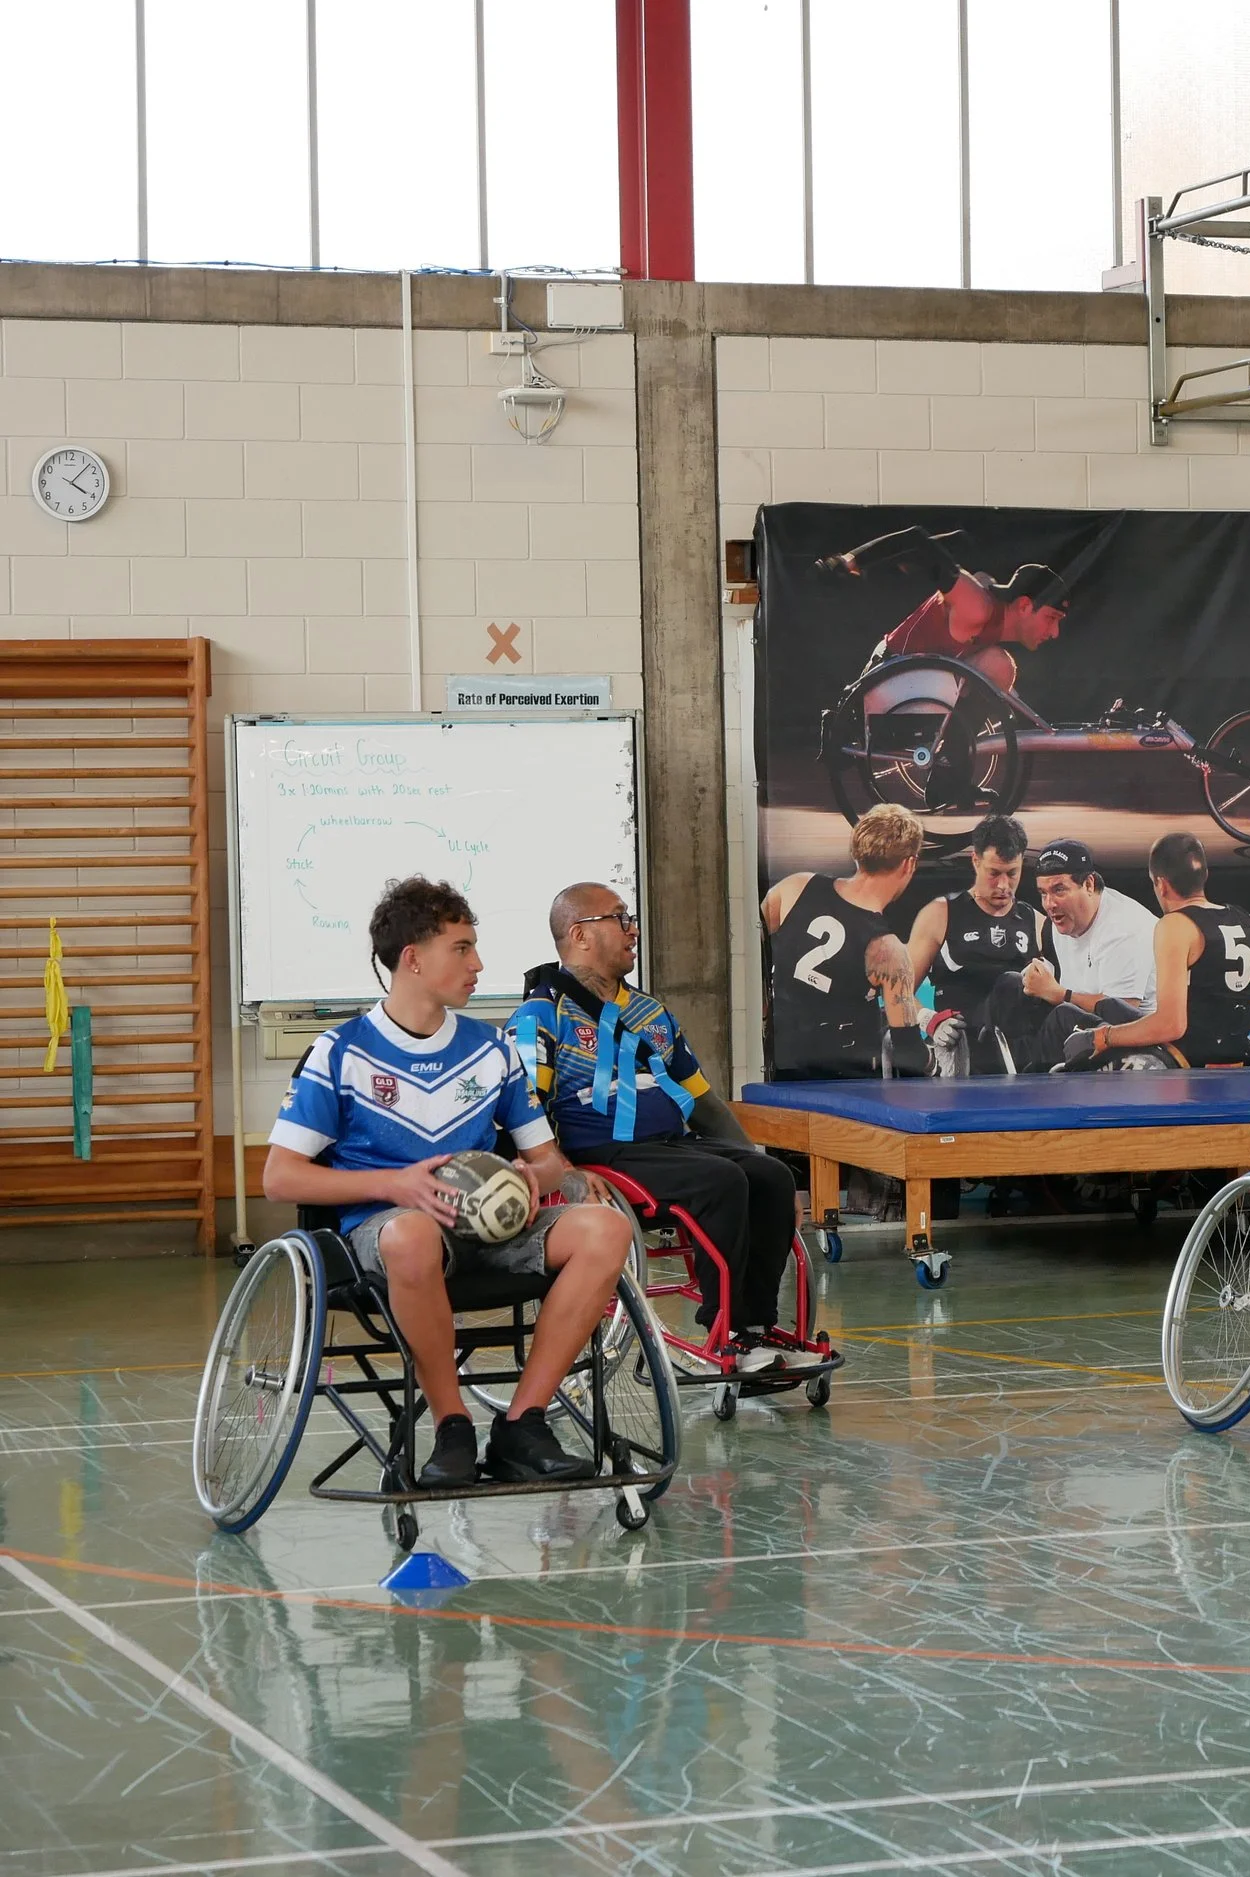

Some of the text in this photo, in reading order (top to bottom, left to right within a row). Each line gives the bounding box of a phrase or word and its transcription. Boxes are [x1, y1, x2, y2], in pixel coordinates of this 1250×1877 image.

[65, 452, 75, 461] 12
[91, 466, 97, 475] 2
[94, 479, 100, 488] 3
[55, 502, 60, 511] 7
[68, 506, 74, 514] 6
[82, 502, 87, 511] 5
[457, 693, 600, 706] Rate of Perceived Exertion
[357, 738, 406, 771] Group
[358, 784, 384, 797] with
[428, 783, 453, 797] rest
[1015, 930, 1029, 953] 3
[793, 915, 846, 994] 2
[410, 1062, 444, 1073] EMU
